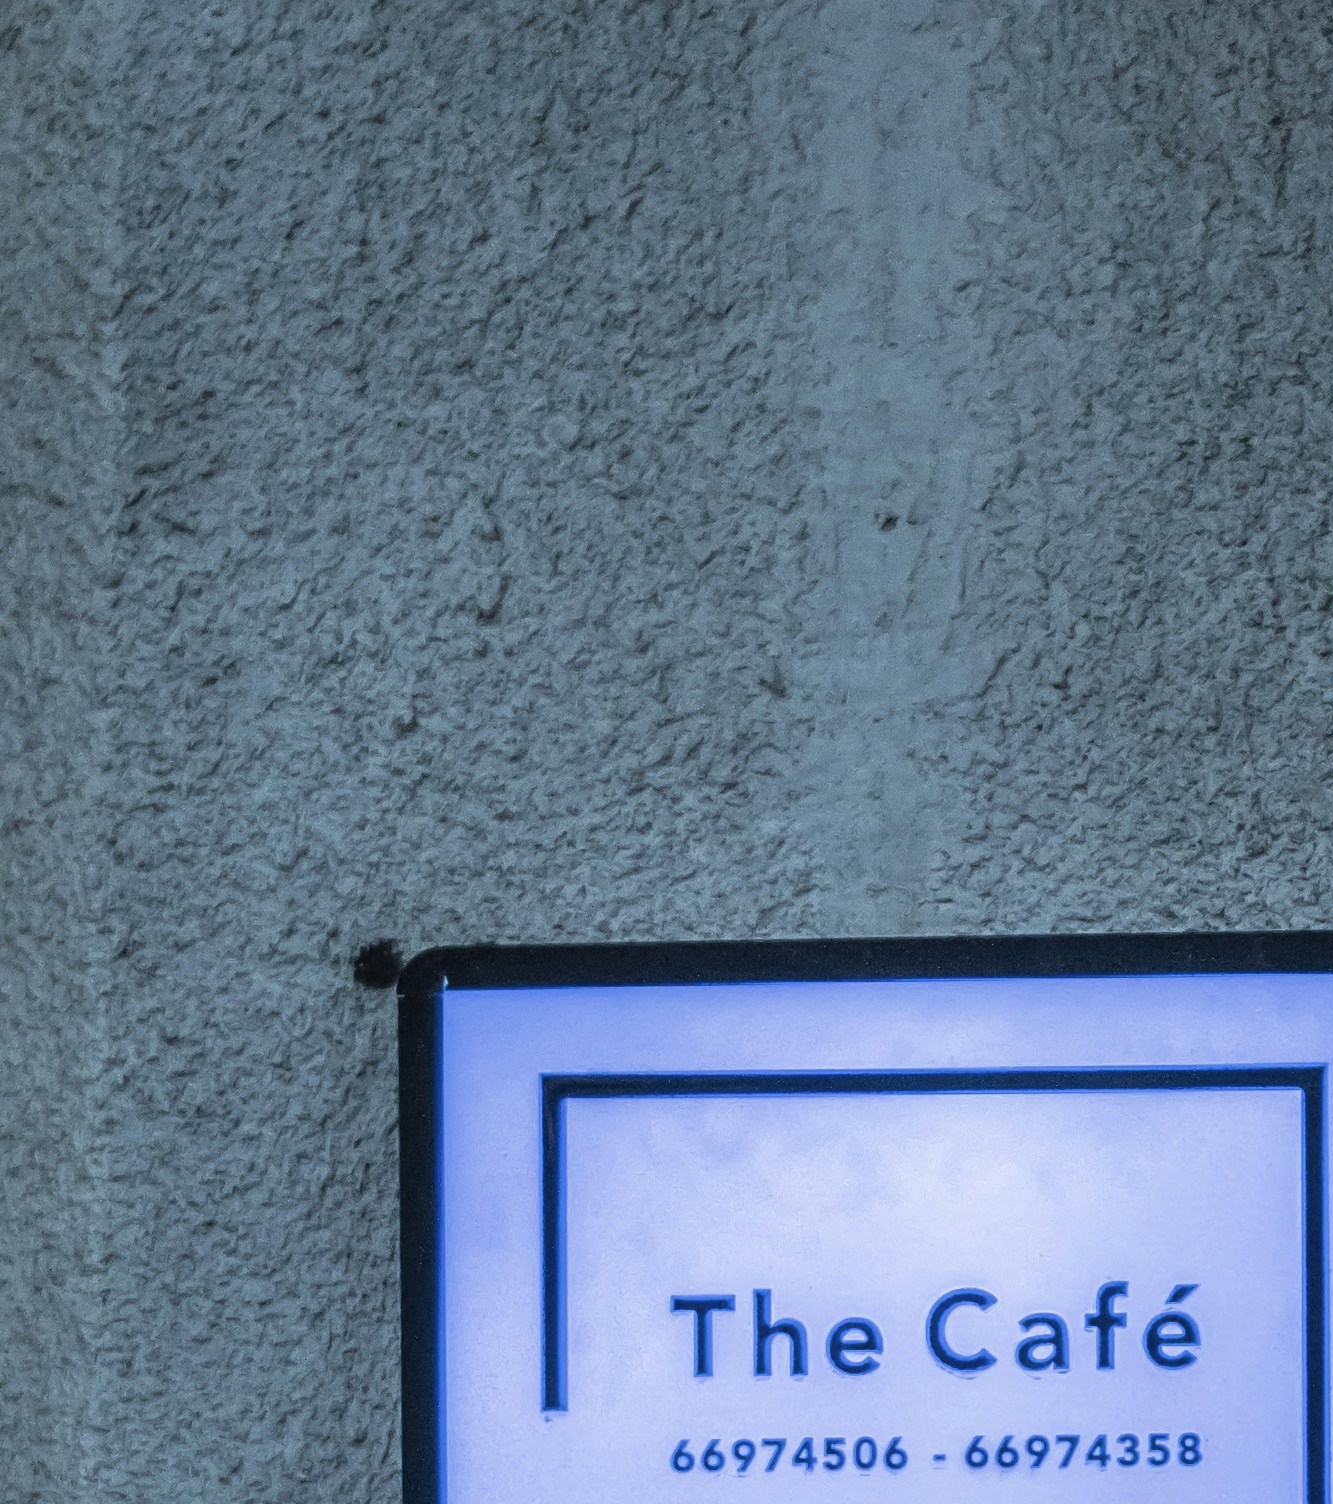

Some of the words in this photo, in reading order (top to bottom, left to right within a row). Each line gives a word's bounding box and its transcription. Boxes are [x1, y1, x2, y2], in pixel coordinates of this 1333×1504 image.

[669, 1288, 885, 1379] The
[925, 1280, 1202, 1377] Café
[669, 1435, 909, 1475] 66974506
[963, 1432, 1203, 1472] 66974358
